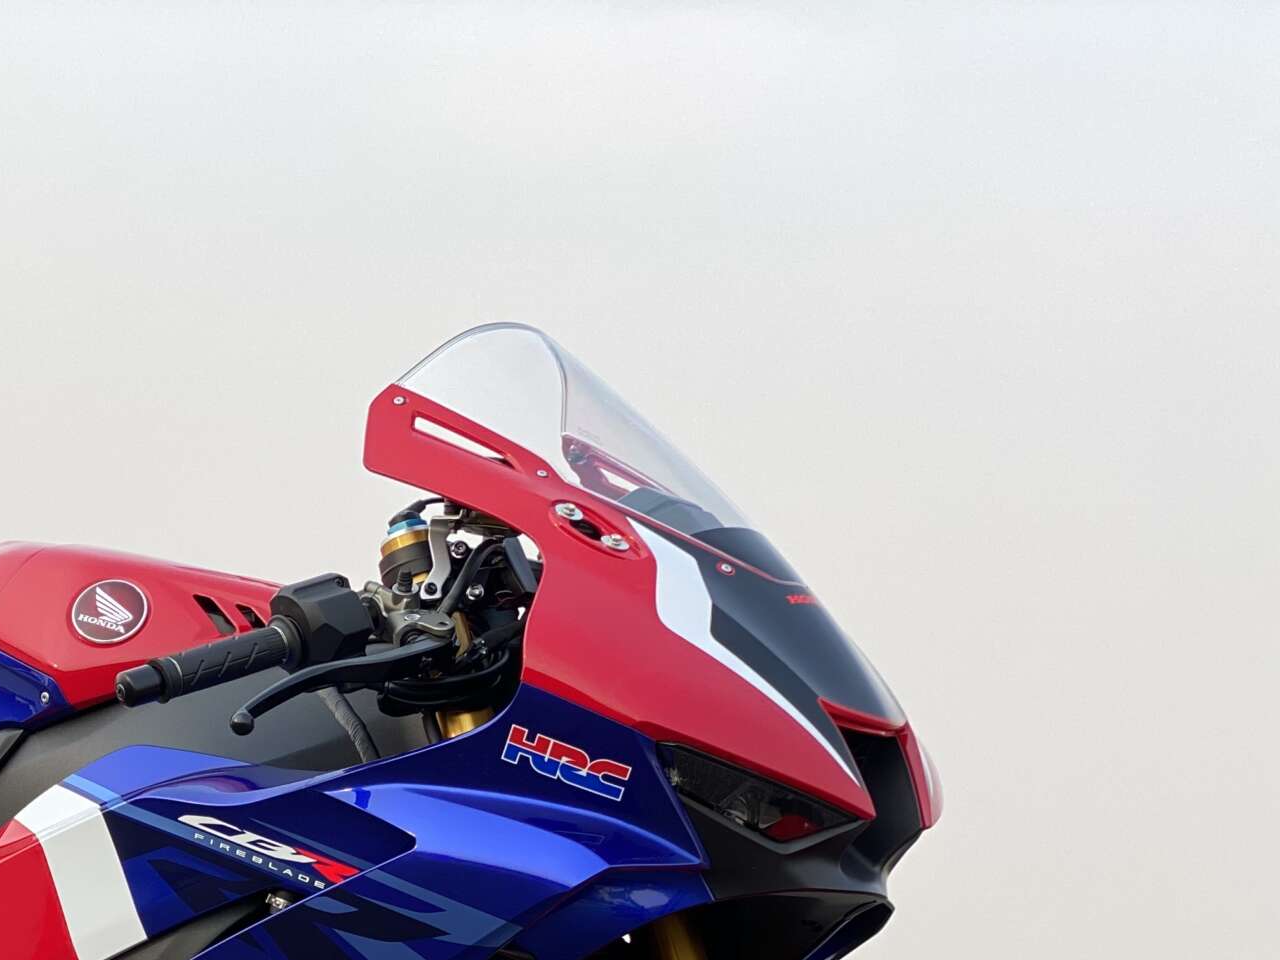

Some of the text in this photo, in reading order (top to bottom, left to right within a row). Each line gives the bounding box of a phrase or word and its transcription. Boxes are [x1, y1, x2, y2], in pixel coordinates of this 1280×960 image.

[77, 613, 126, 634] HONDA
[501, 723, 633, 802] HRC
[193, 832, 327, 891] FIREBLADE
